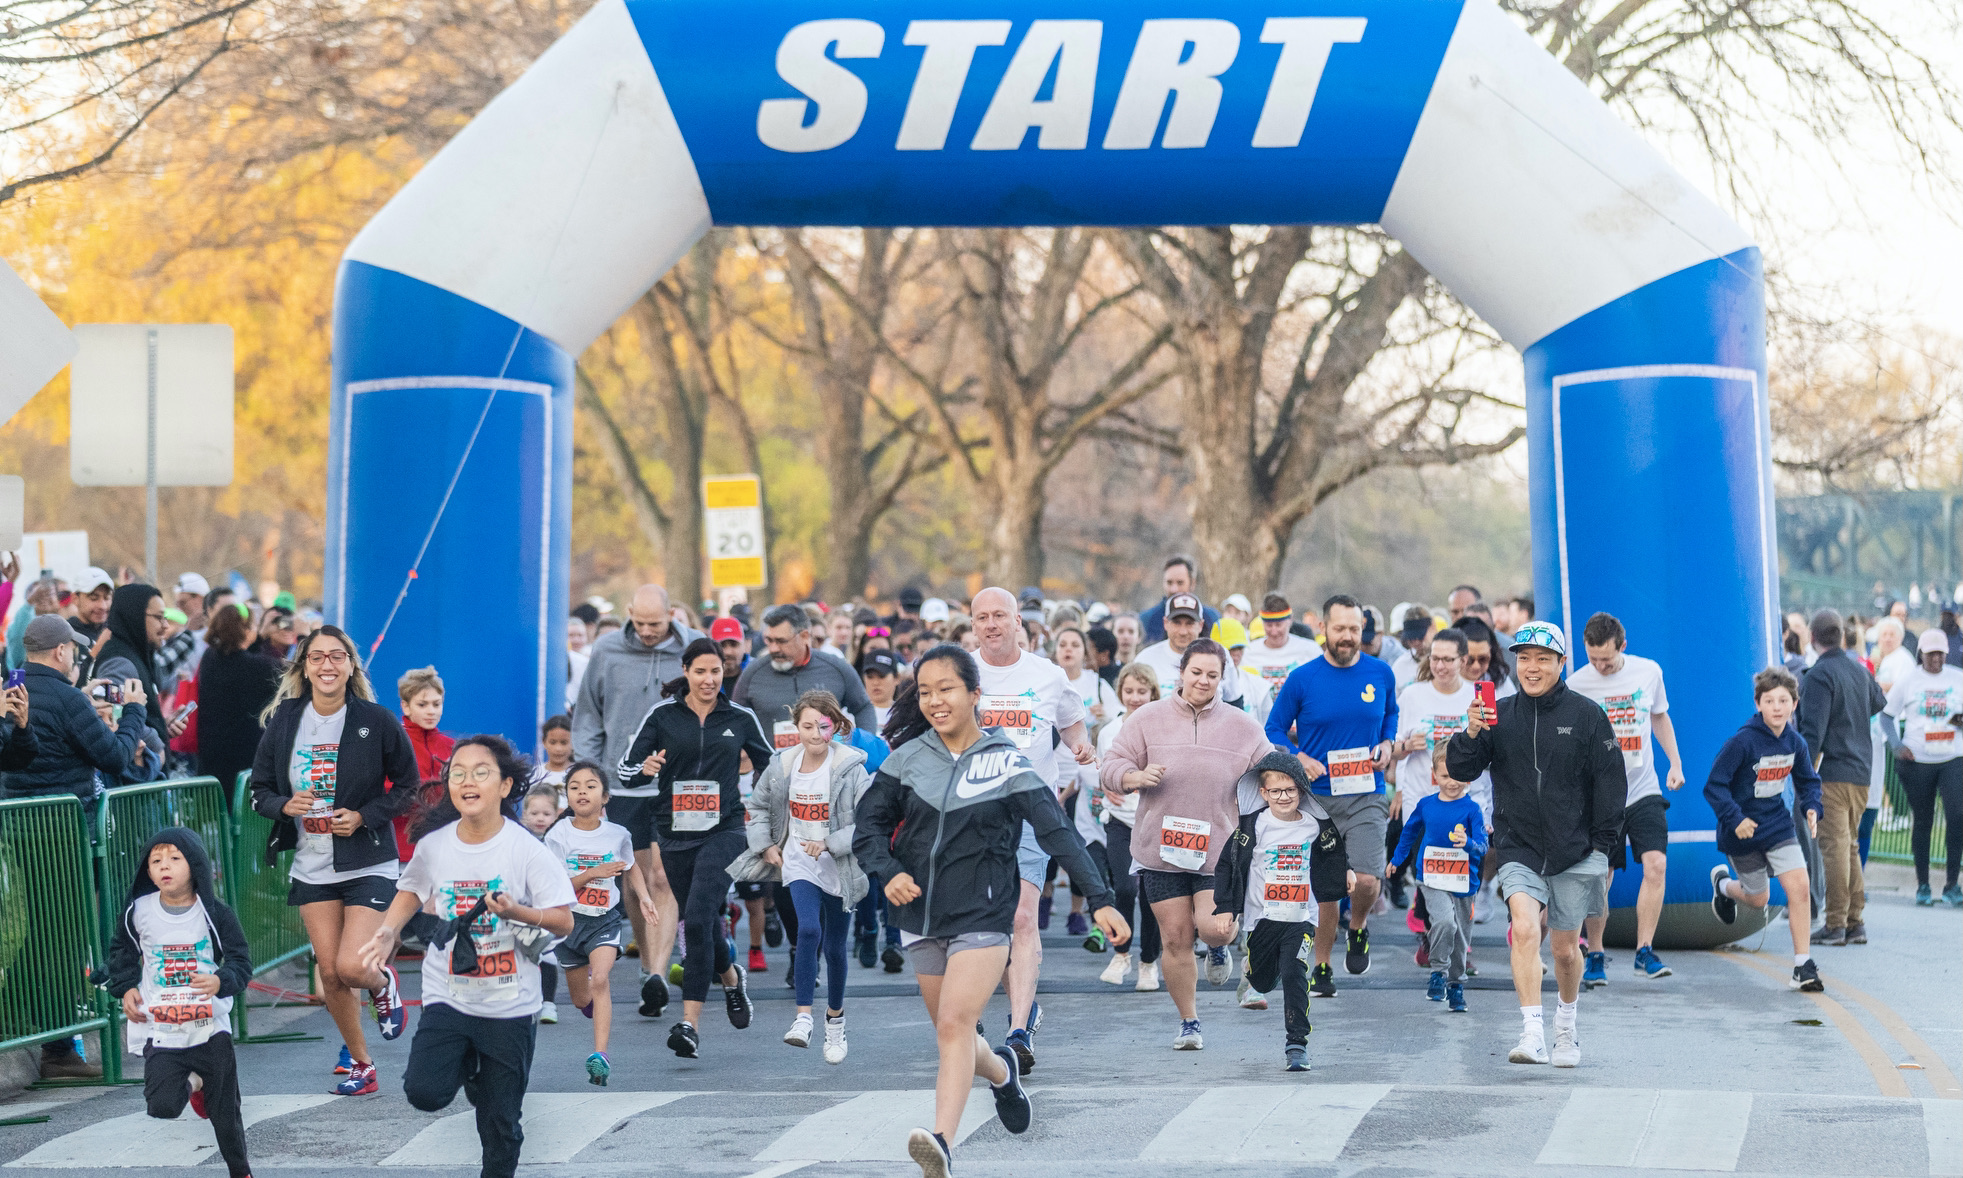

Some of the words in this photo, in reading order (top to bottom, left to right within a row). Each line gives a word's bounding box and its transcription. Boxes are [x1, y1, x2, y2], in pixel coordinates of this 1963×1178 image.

[757, 17, 1368, 153] START
[720, 533, 753, 554] 20
[983, 710, 1029, 727] 6790
[311, 759, 337, 773] ZO
[967, 750, 1021, 780] NIKE
[1332, 760, 1371, 777] 6876
[675, 794, 716, 811] 4396
[792, 802, 829, 821] 6788
[1164, 830, 1206, 850] 6870
[1278, 855, 1302, 864] ZOO
[1426, 859, 1467, 873] 6877
[577, 887, 608, 906] 765
[1267, 884, 1306, 900] 6871
[164, 957, 198, 972] ZOO
